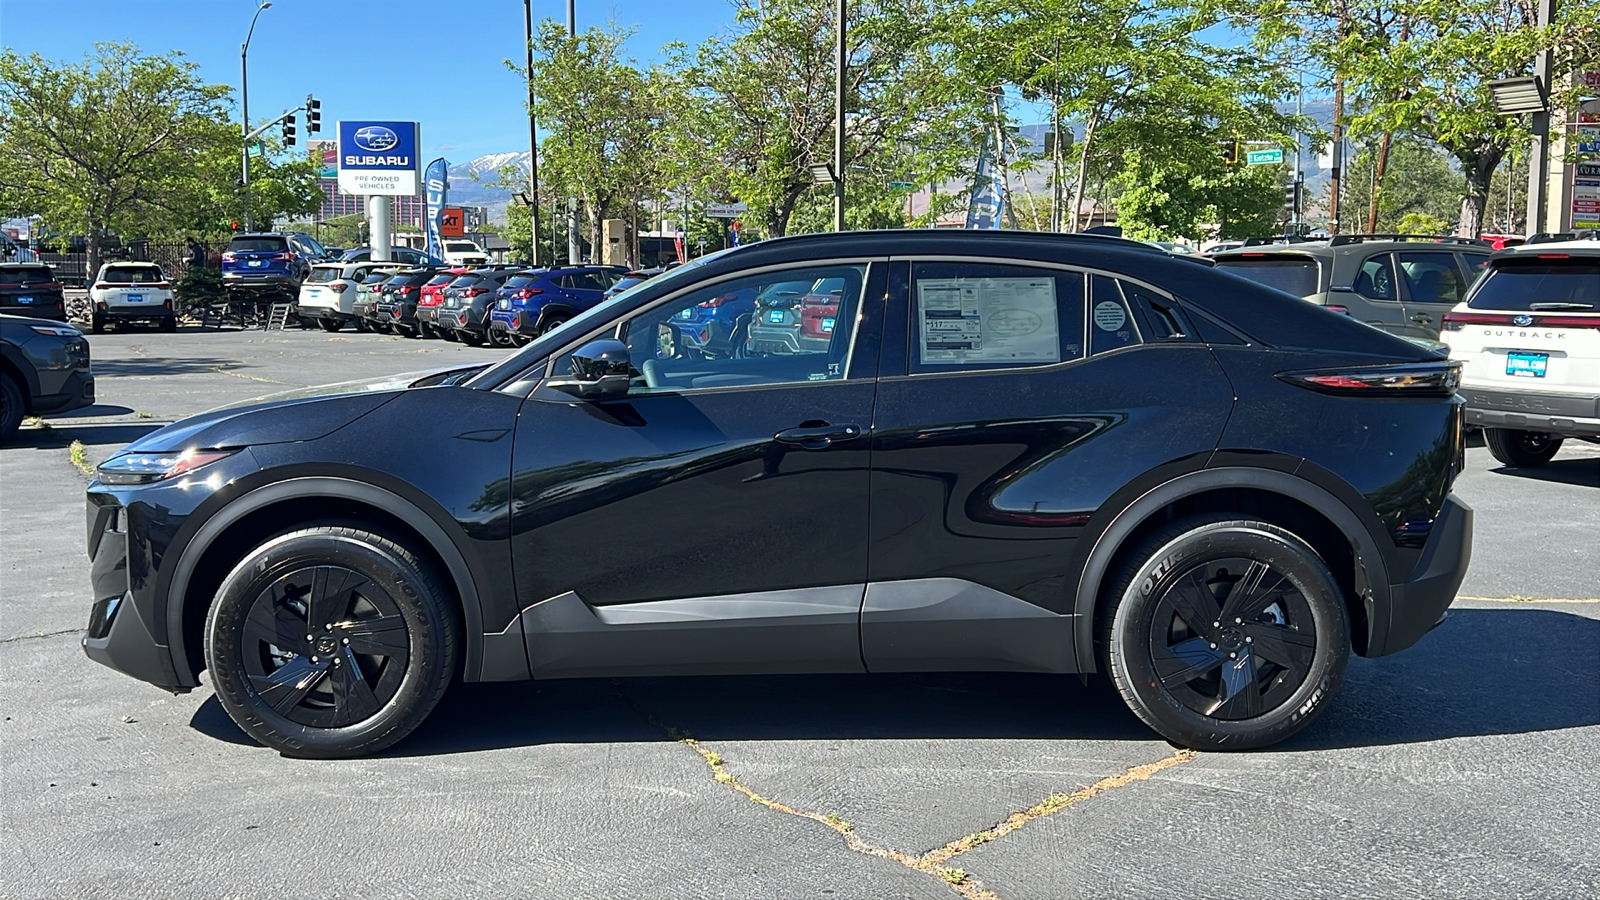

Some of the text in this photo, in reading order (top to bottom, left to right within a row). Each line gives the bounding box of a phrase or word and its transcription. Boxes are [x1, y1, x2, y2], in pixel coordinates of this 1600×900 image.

[345, 155, 409, 166] SUBARU
[426, 179, 444, 260] SUBA
[441, 215, 459, 226] IXT
[1484, 330, 1566, 339] OUTBACK
